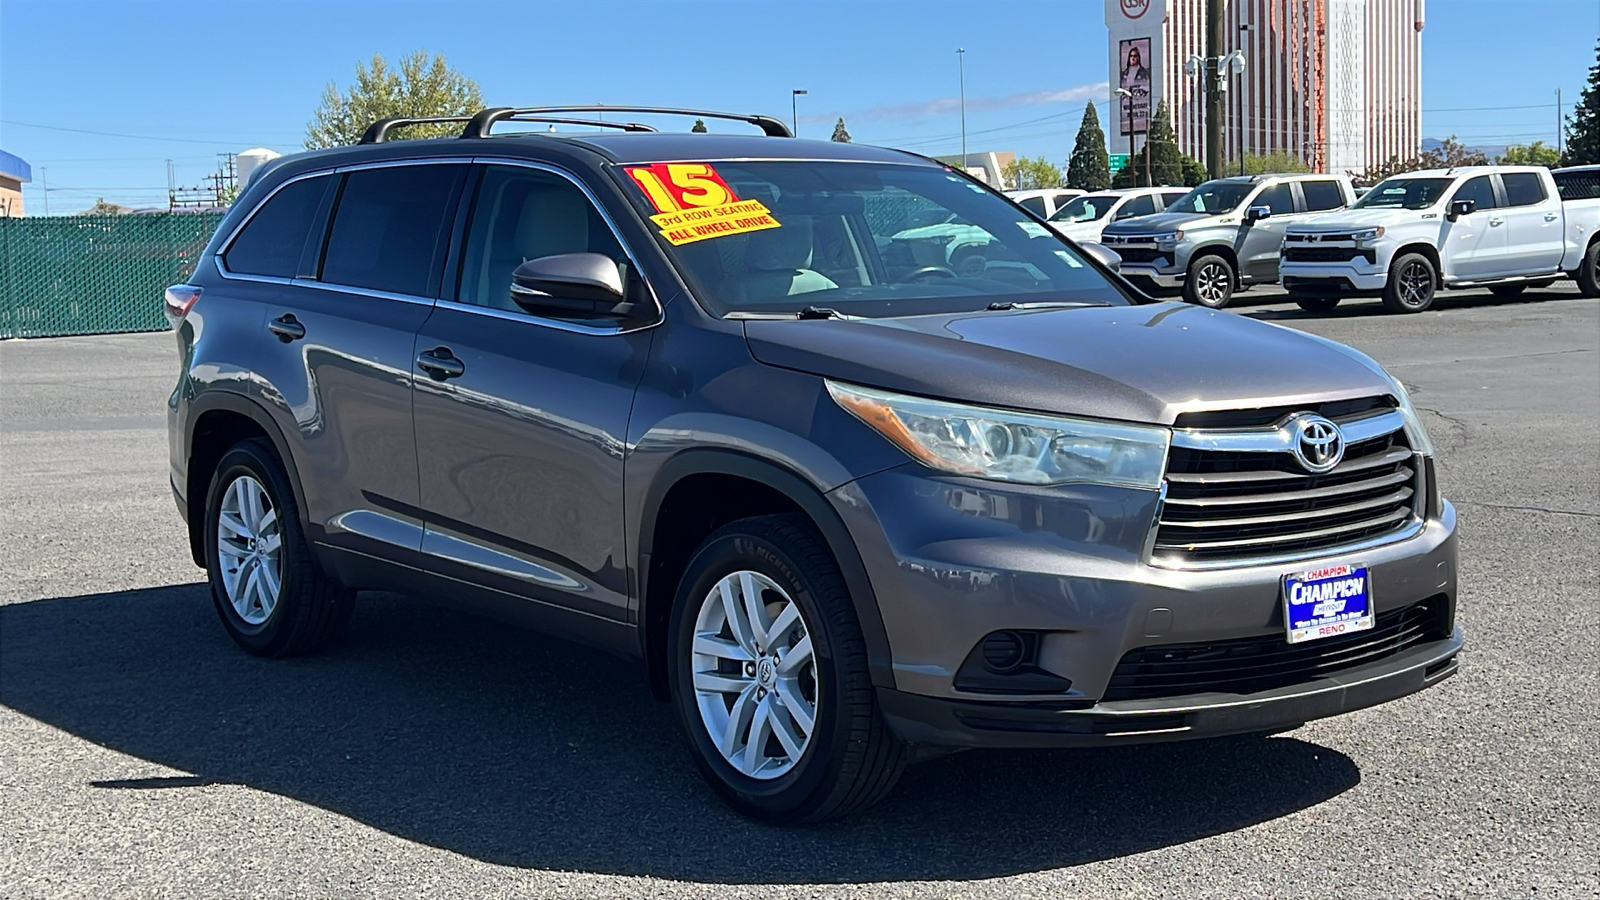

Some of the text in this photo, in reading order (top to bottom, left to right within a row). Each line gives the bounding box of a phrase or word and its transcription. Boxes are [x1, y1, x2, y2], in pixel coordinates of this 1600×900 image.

[632, 163, 731, 213] 15
[659, 202, 764, 226] 3rd ROW SEATING
[668, 215, 772, 241] ALL WHEEL DRIVE
[1307, 566, 1347, 580] CHAMPION
[1290, 577, 1364, 605] CHAMPION
[1319, 624, 1346, 636] RENO
